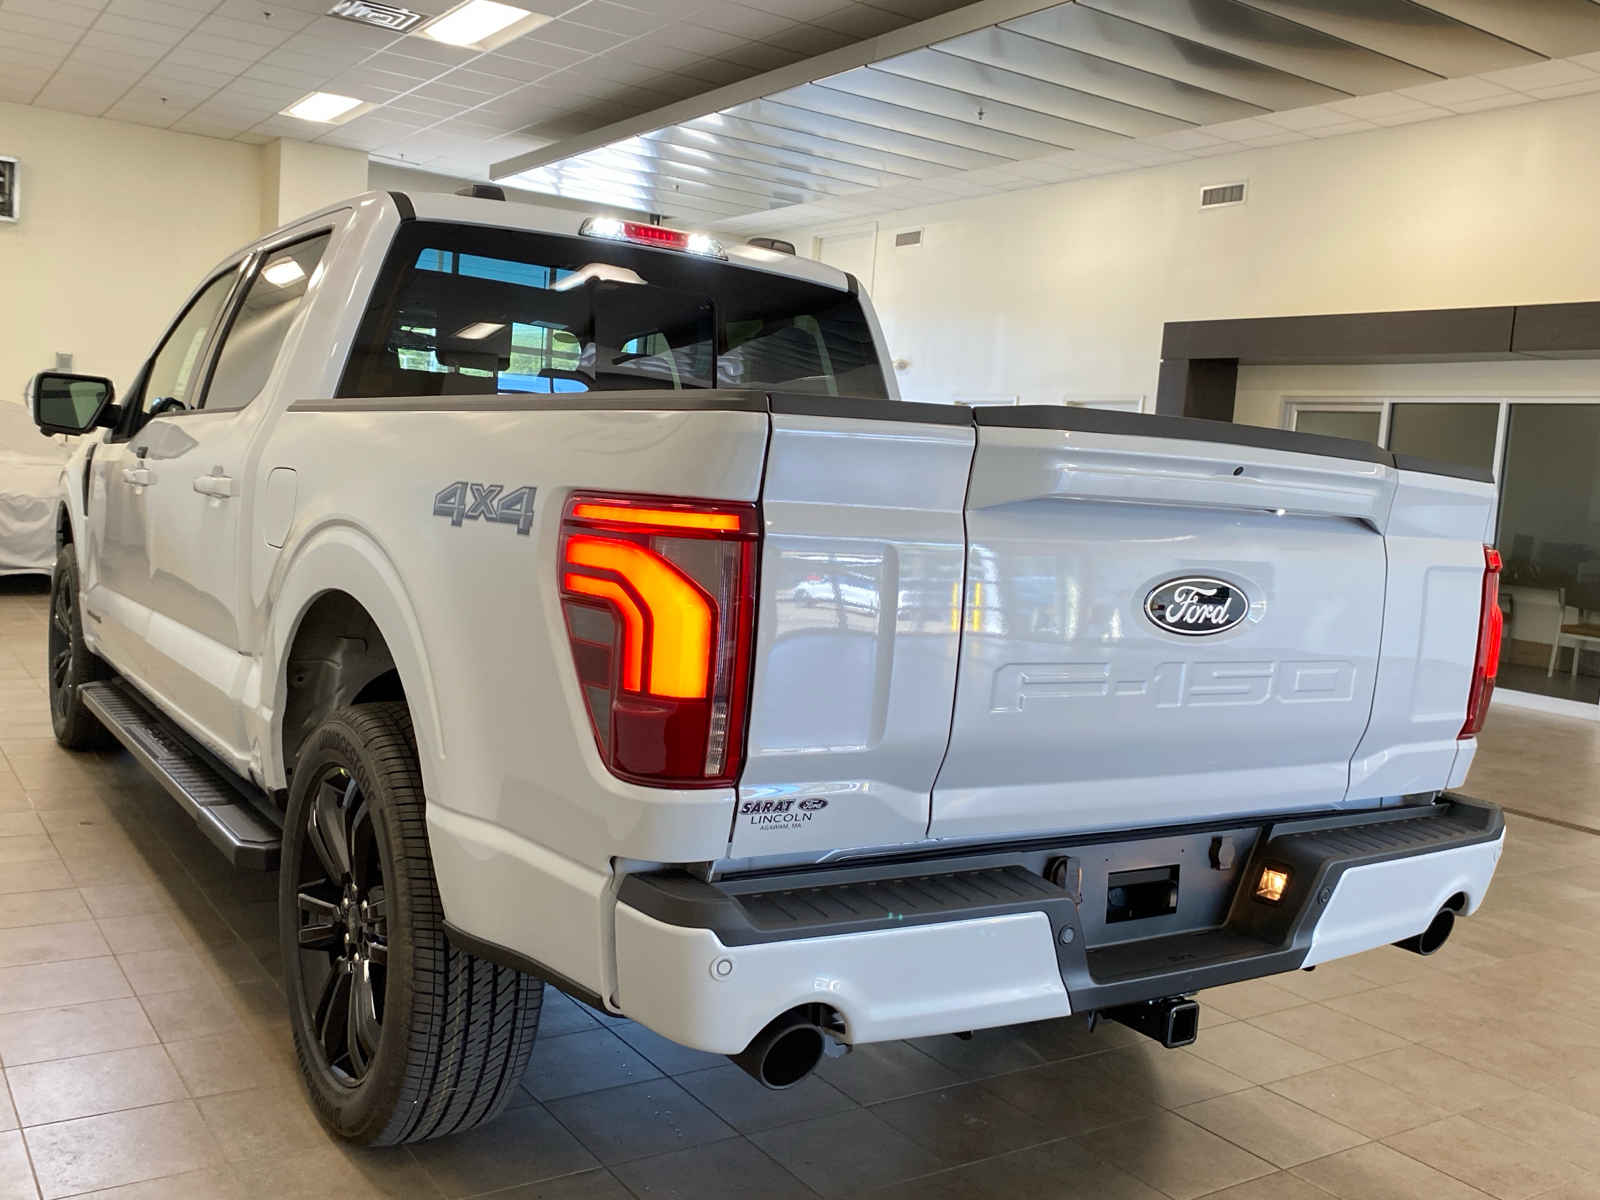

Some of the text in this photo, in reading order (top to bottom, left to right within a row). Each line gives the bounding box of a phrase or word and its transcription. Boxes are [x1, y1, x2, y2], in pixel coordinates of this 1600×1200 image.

[1165, 585, 1232, 625] Ford
[990, 661, 1356, 713] F-150
[740, 799, 796, 814] SARAT
[750, 813, 813, 824] LINCOLN
